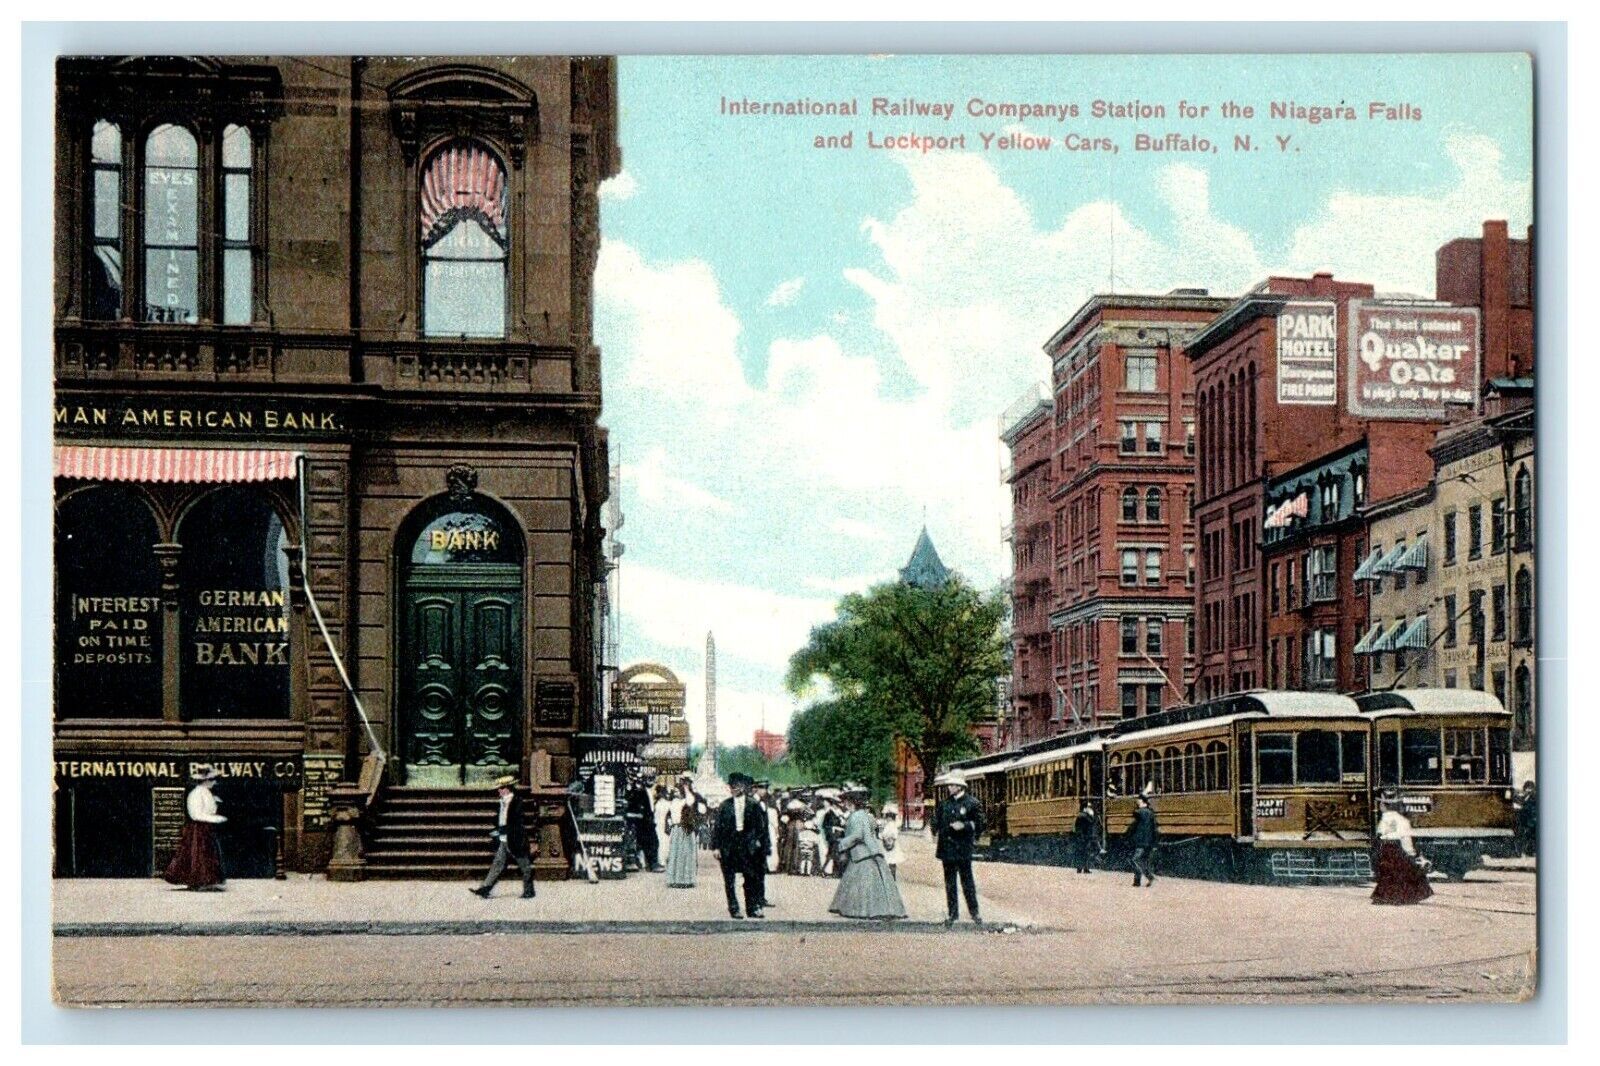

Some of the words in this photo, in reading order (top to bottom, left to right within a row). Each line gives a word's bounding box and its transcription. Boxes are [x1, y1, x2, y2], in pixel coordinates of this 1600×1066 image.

[1281, 314, 1334, 338] PARK
[1281, 340, 1334, 357] HOTEL
[1360, 332, 1470, 372] Quaker
[1390, 361, 1456, 385] Oats
[122, 408, 252, 428] AMERICAN
[264, 410, 344, 431] BANK.
[430, 528, 499, 551] BANK
[72, 593, 160, 621] INTEREST
[200, 590, 285, 607] GERMAN
[90, 619, 148, 631] PAID
[195, 617, 289, 633] AMERICAN
[79, 636, 100, 648] ON
[106, 635, 151, 648] TIME
[74, 653, 151, 665] DEPOSITS
[196, 643, 288, 665] BANK
[612, 719, 644, 731] CLOTHING
[648, 714, 670, 737] HUB
[274, 761, 301, 778] CO.
[590, 846, 612, 855] THE
[575, 853, 622, 871] NEWS
